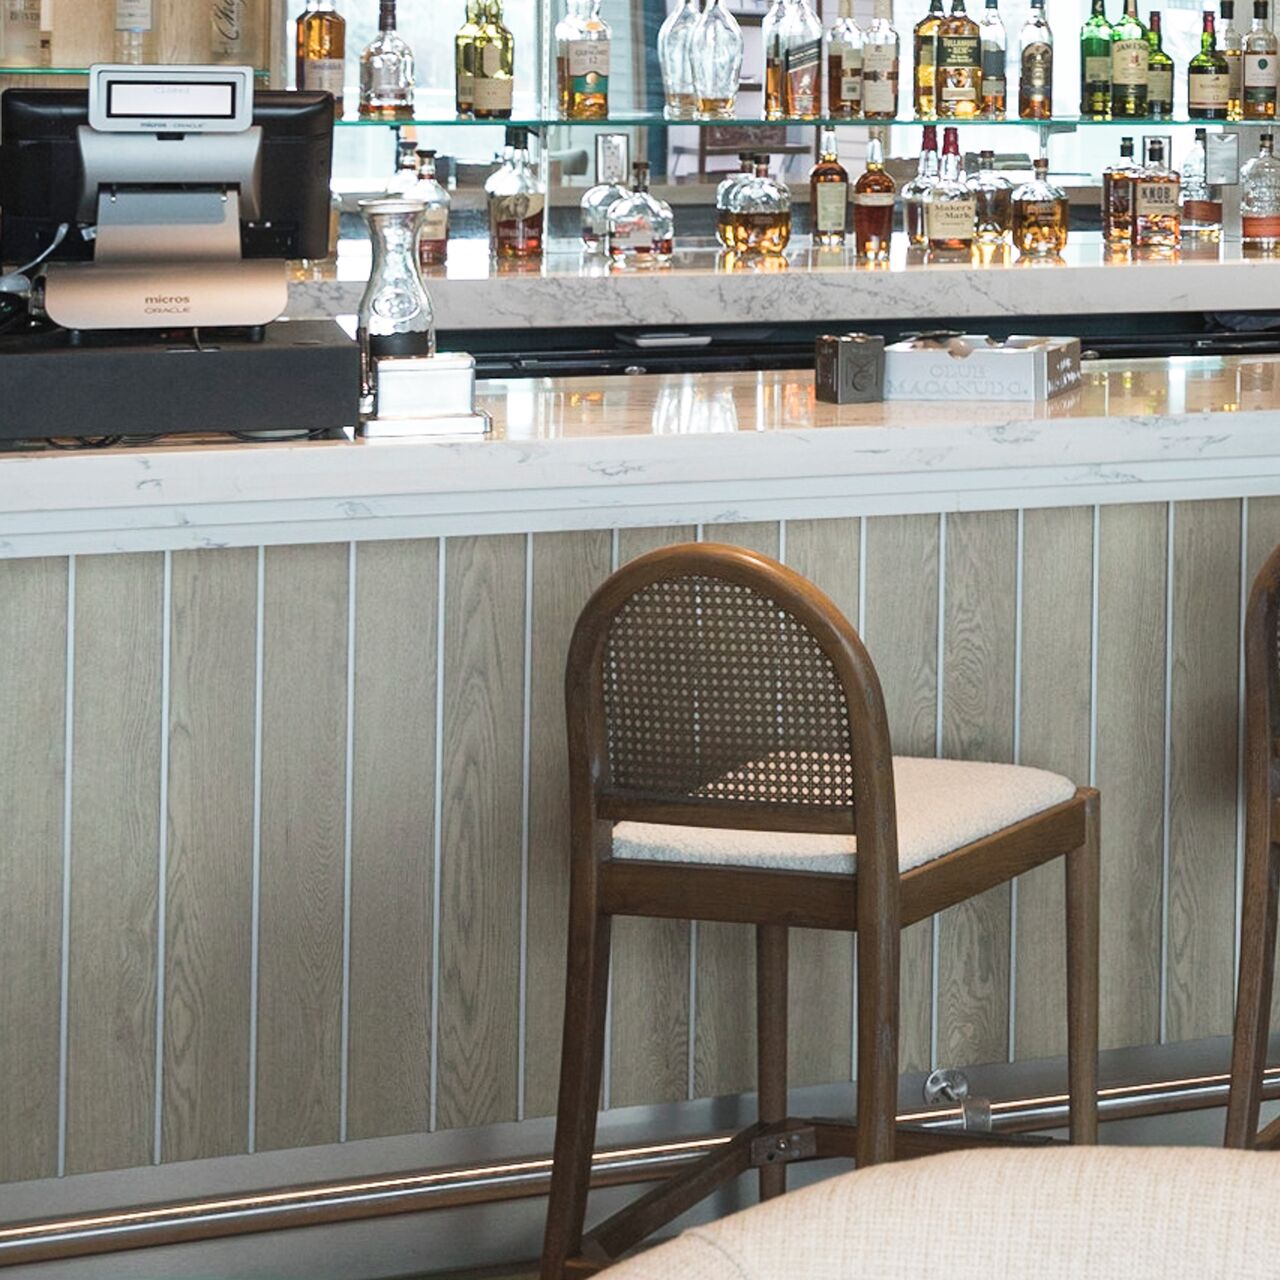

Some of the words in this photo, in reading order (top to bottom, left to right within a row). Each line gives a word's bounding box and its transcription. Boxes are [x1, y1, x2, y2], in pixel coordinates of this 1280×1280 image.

[589, 55, 598, 64] 12
[1141, 186, 1171, 200] KNOB
[144, 294, 190, 304] micros
[930, 364, 987, 379] CLUB
